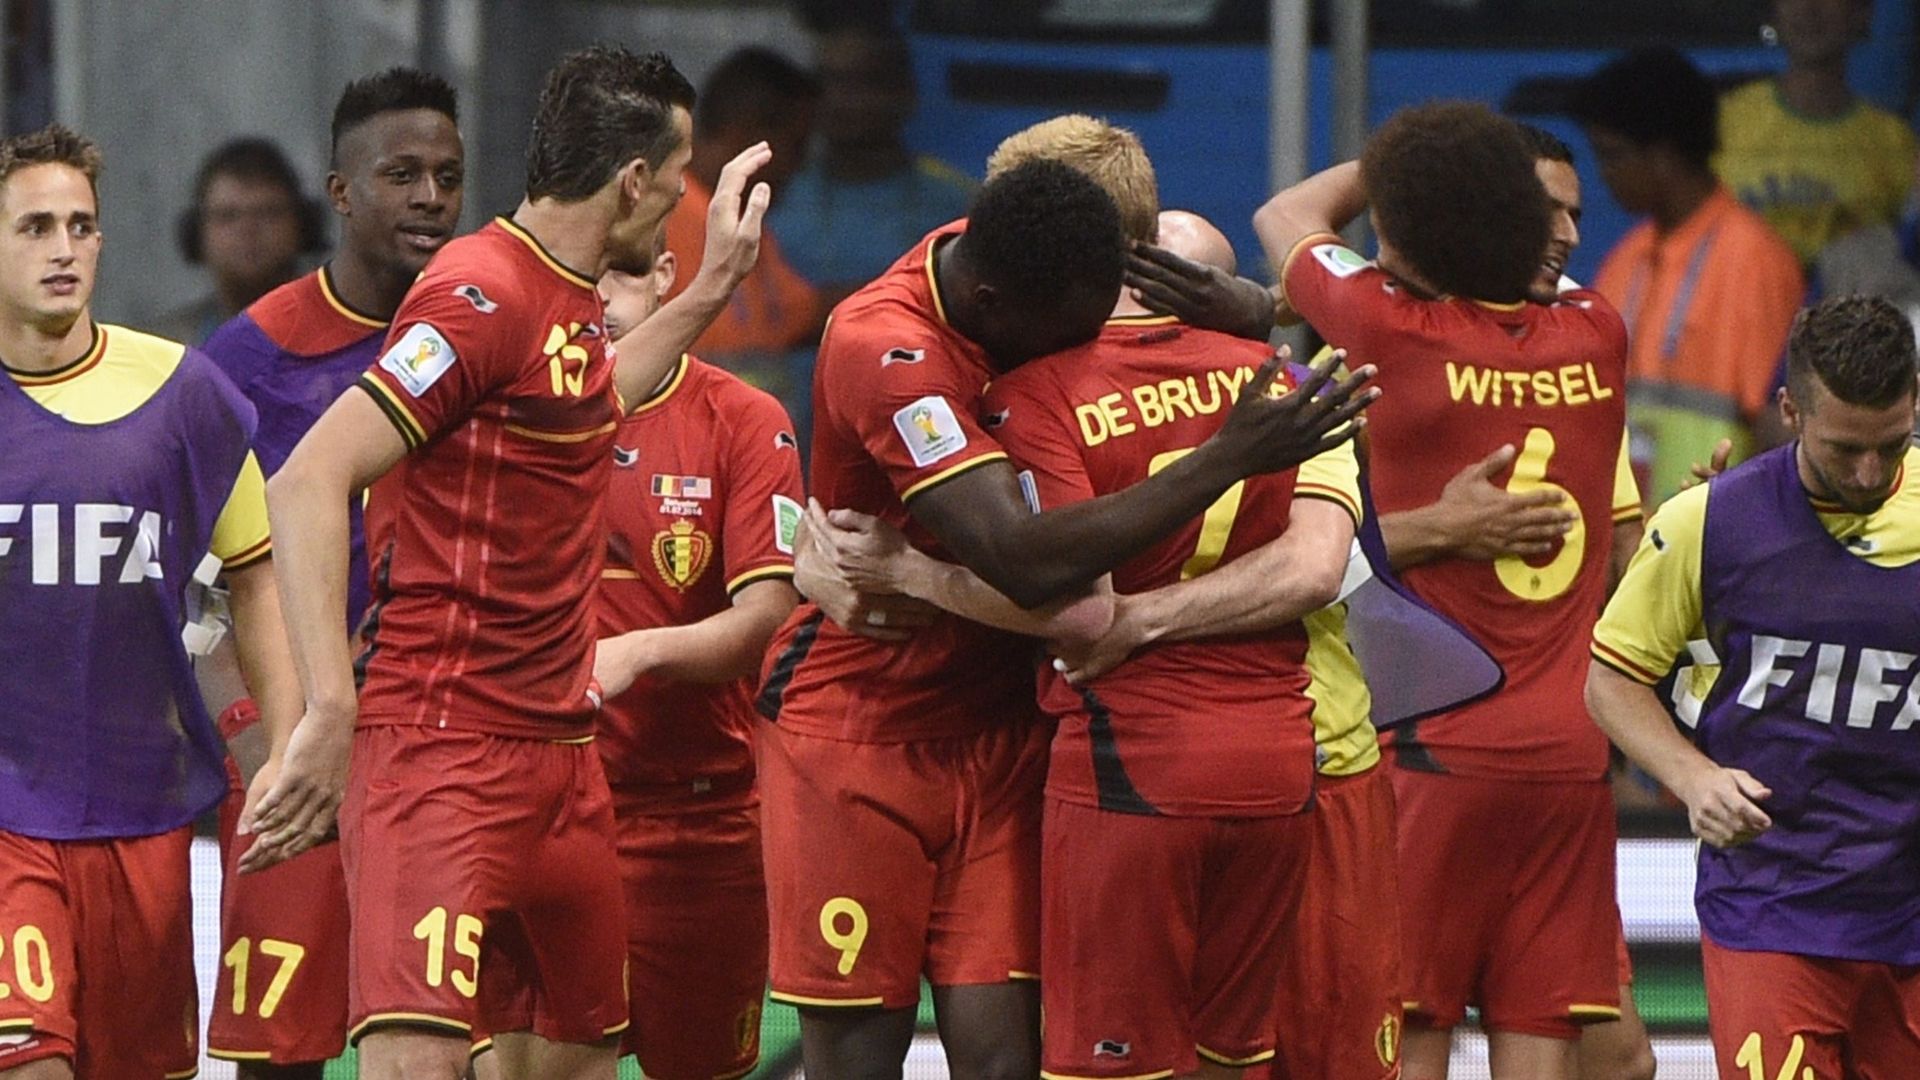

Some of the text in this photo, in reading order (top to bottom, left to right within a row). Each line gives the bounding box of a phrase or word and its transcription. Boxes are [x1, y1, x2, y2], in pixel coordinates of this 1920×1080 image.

[542, 321, 589, 398] 15
[1445, 361, 1613, 407] WITSEL
[1075, 364, 1290, 447] DE BRUY
[1493, 427, 1586, 601] 6
[224, 936, 305, 1018] 17
[413, 906, 483, 998] 15
[819, 896, 868, 976] 9
